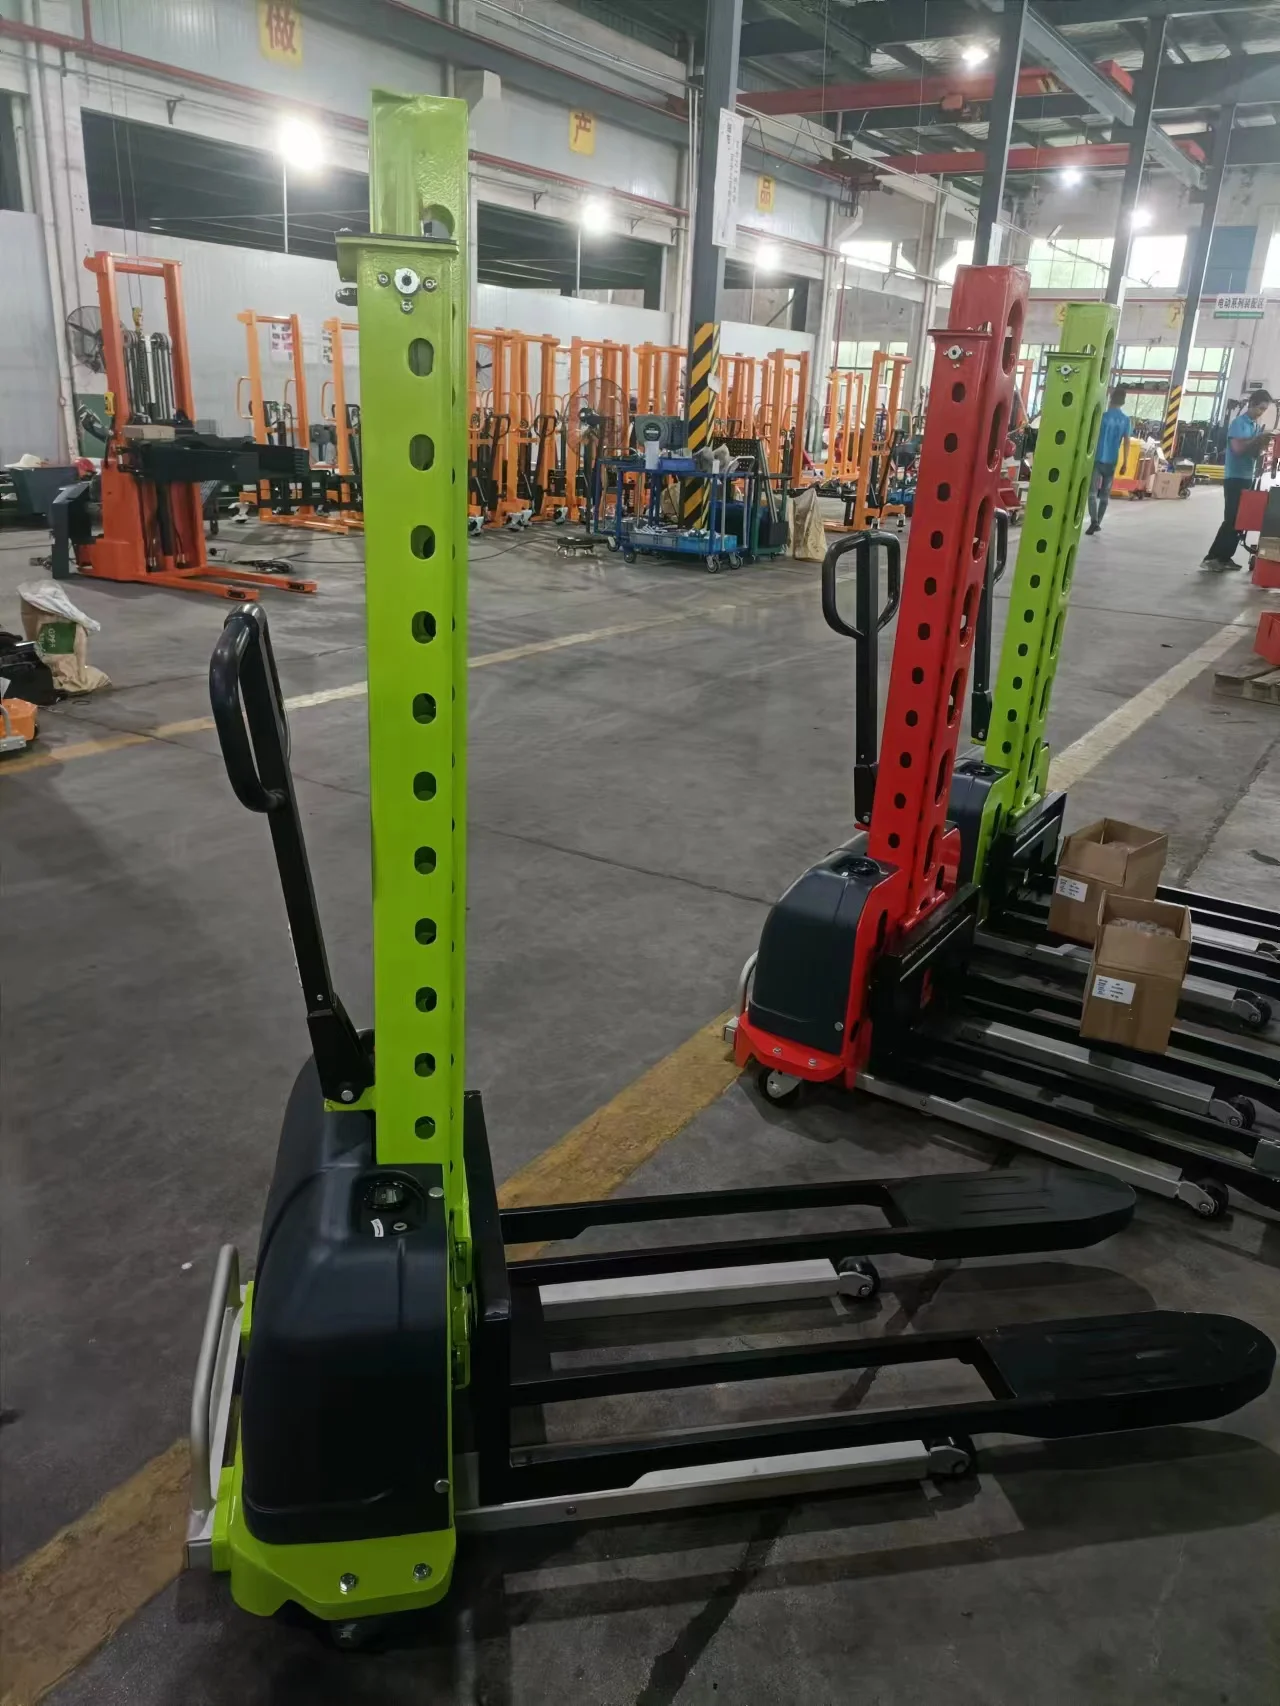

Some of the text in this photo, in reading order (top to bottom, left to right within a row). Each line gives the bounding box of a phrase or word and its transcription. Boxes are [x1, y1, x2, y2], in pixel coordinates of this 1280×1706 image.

[265, 1, 297, 54] 做
[574, 111, 592, 144] 产
[761, 177, 772, 204] 品
[1217, 296, 1264, 309] 电动系列装配区
